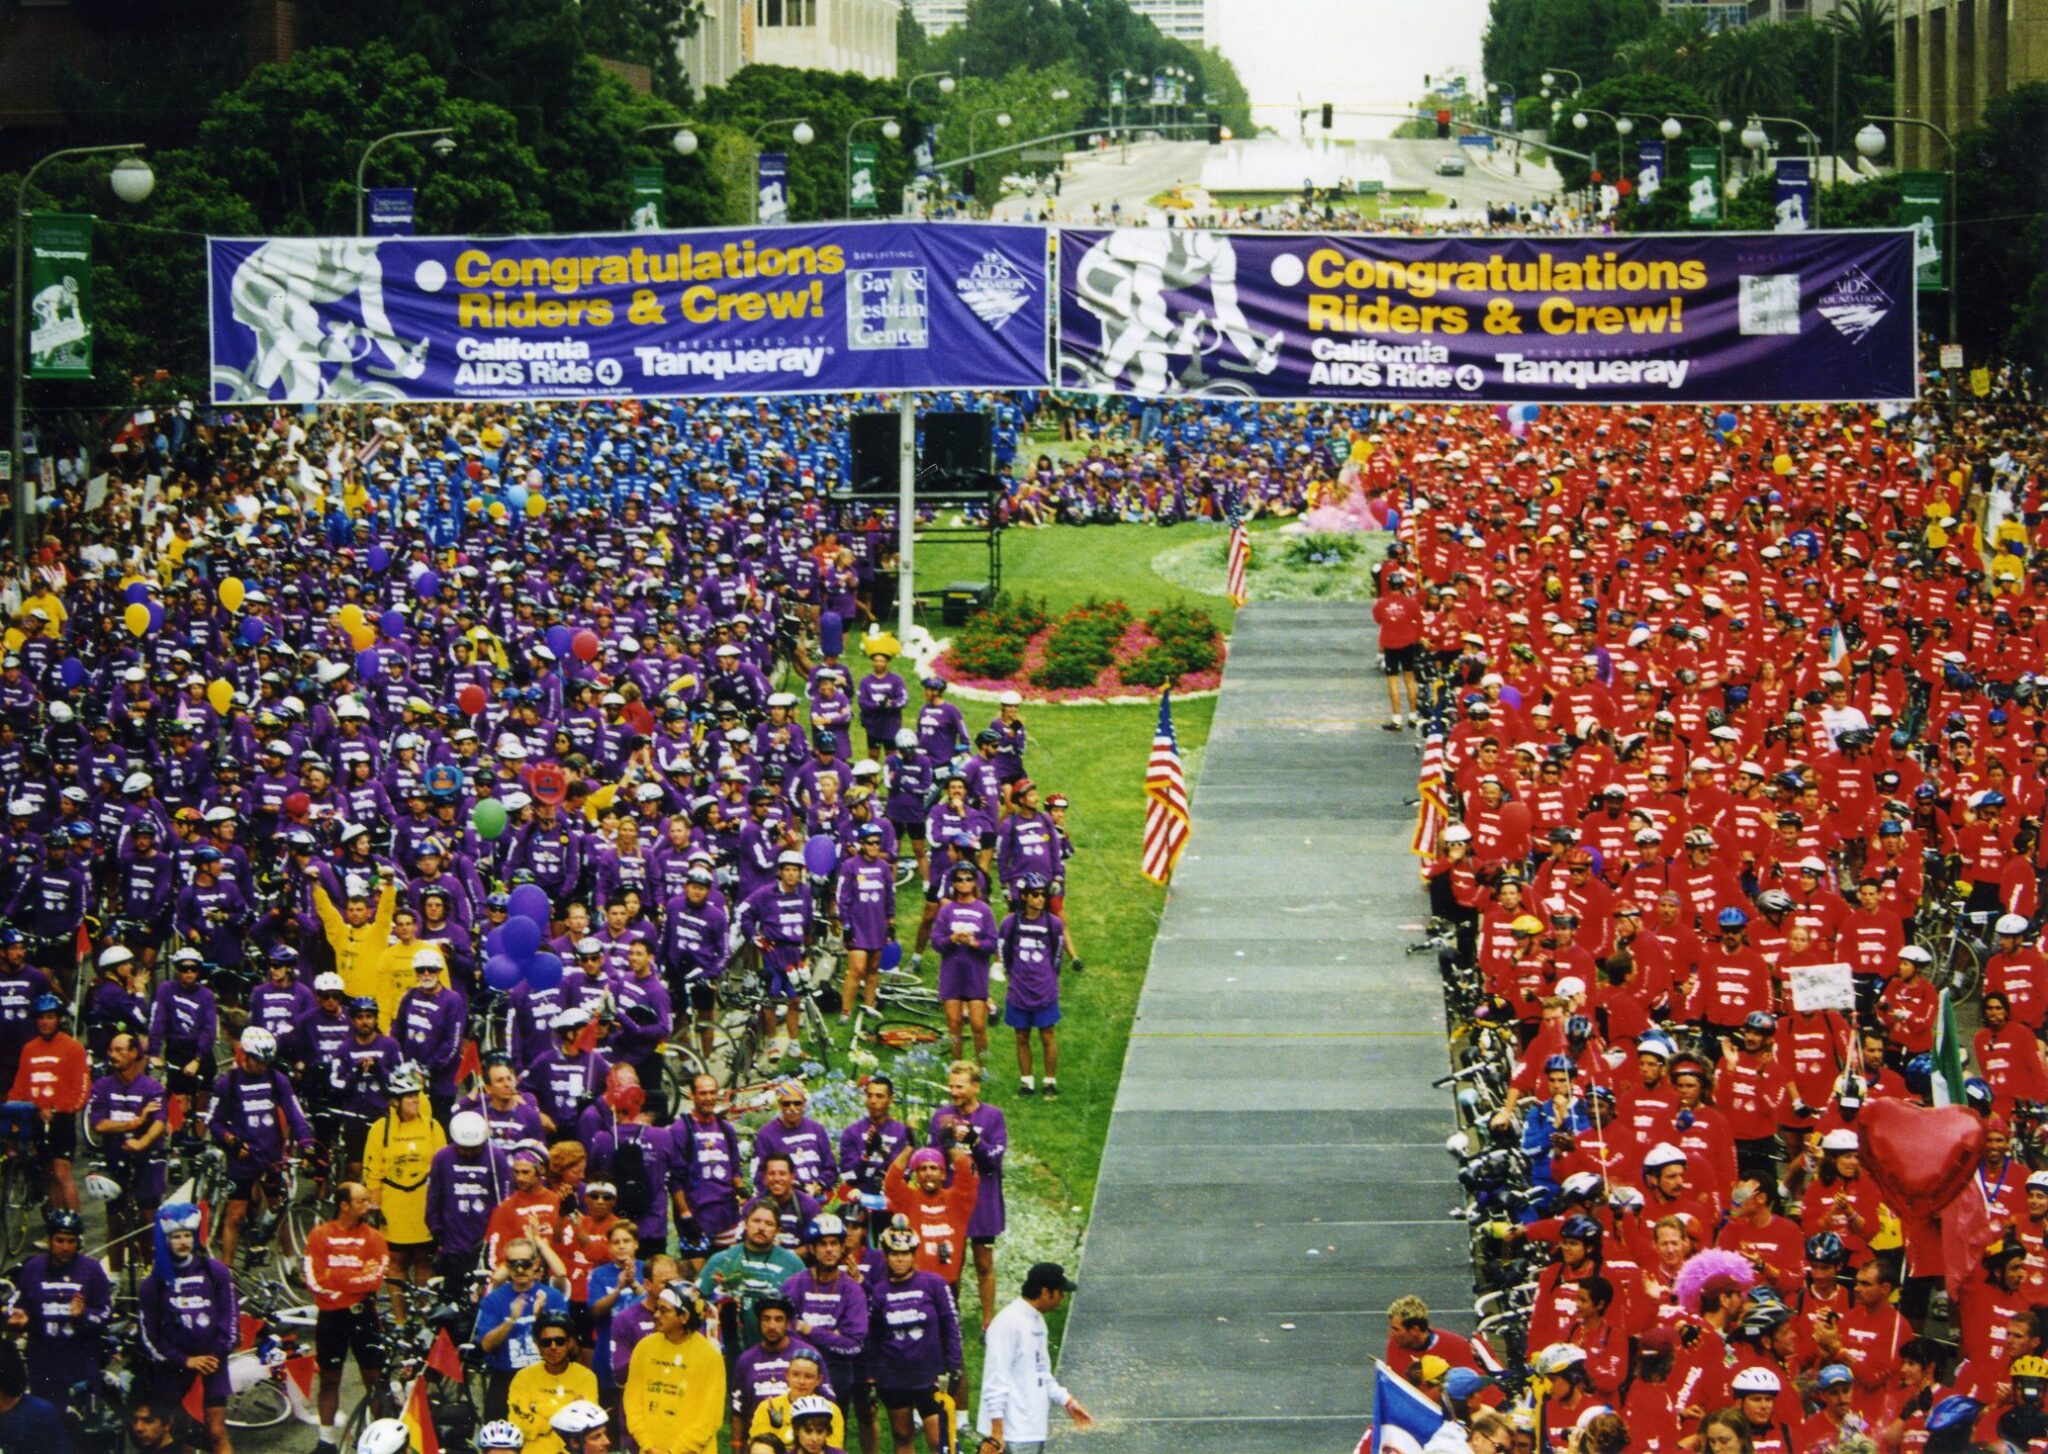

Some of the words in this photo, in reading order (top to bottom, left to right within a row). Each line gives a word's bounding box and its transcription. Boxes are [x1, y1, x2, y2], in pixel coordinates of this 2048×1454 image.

[455, 241, 846, 294] Congratulations
[970, 265, 1010, 280] AIDS
[1308, 249, 1708, 299] Congratulations
[853, 271, 897, 296] Gay
[903, 269, 926, 292] &
[956, 278, 1025, 291] FOUNDATION
[458, 291, 614, 329] Riders
[627, 289, 668, 326] &
[681, 280, 826, 324] Crew!
[848, 296, 926, 319] Lesbian
[1308, 294, 1469, 335] Riders
[1483, 297, 1524, 335] &
[1537, 296, 1684, 335] Crew!
[854, 322, 927, 346] Center
[455, 336, 590, 362] California
[1311, 337, 1449, 364] California
[454, 362, 527, 387] AIDS
[531, 360, 594, 385] Ride
[634, 345, 825, 381] Tanqueray
[1308, 364, 1383, 388] AIDS
[1386, 363, 1452, 388] Ride
[1495, 352, 1690, 390] Tanqueray
